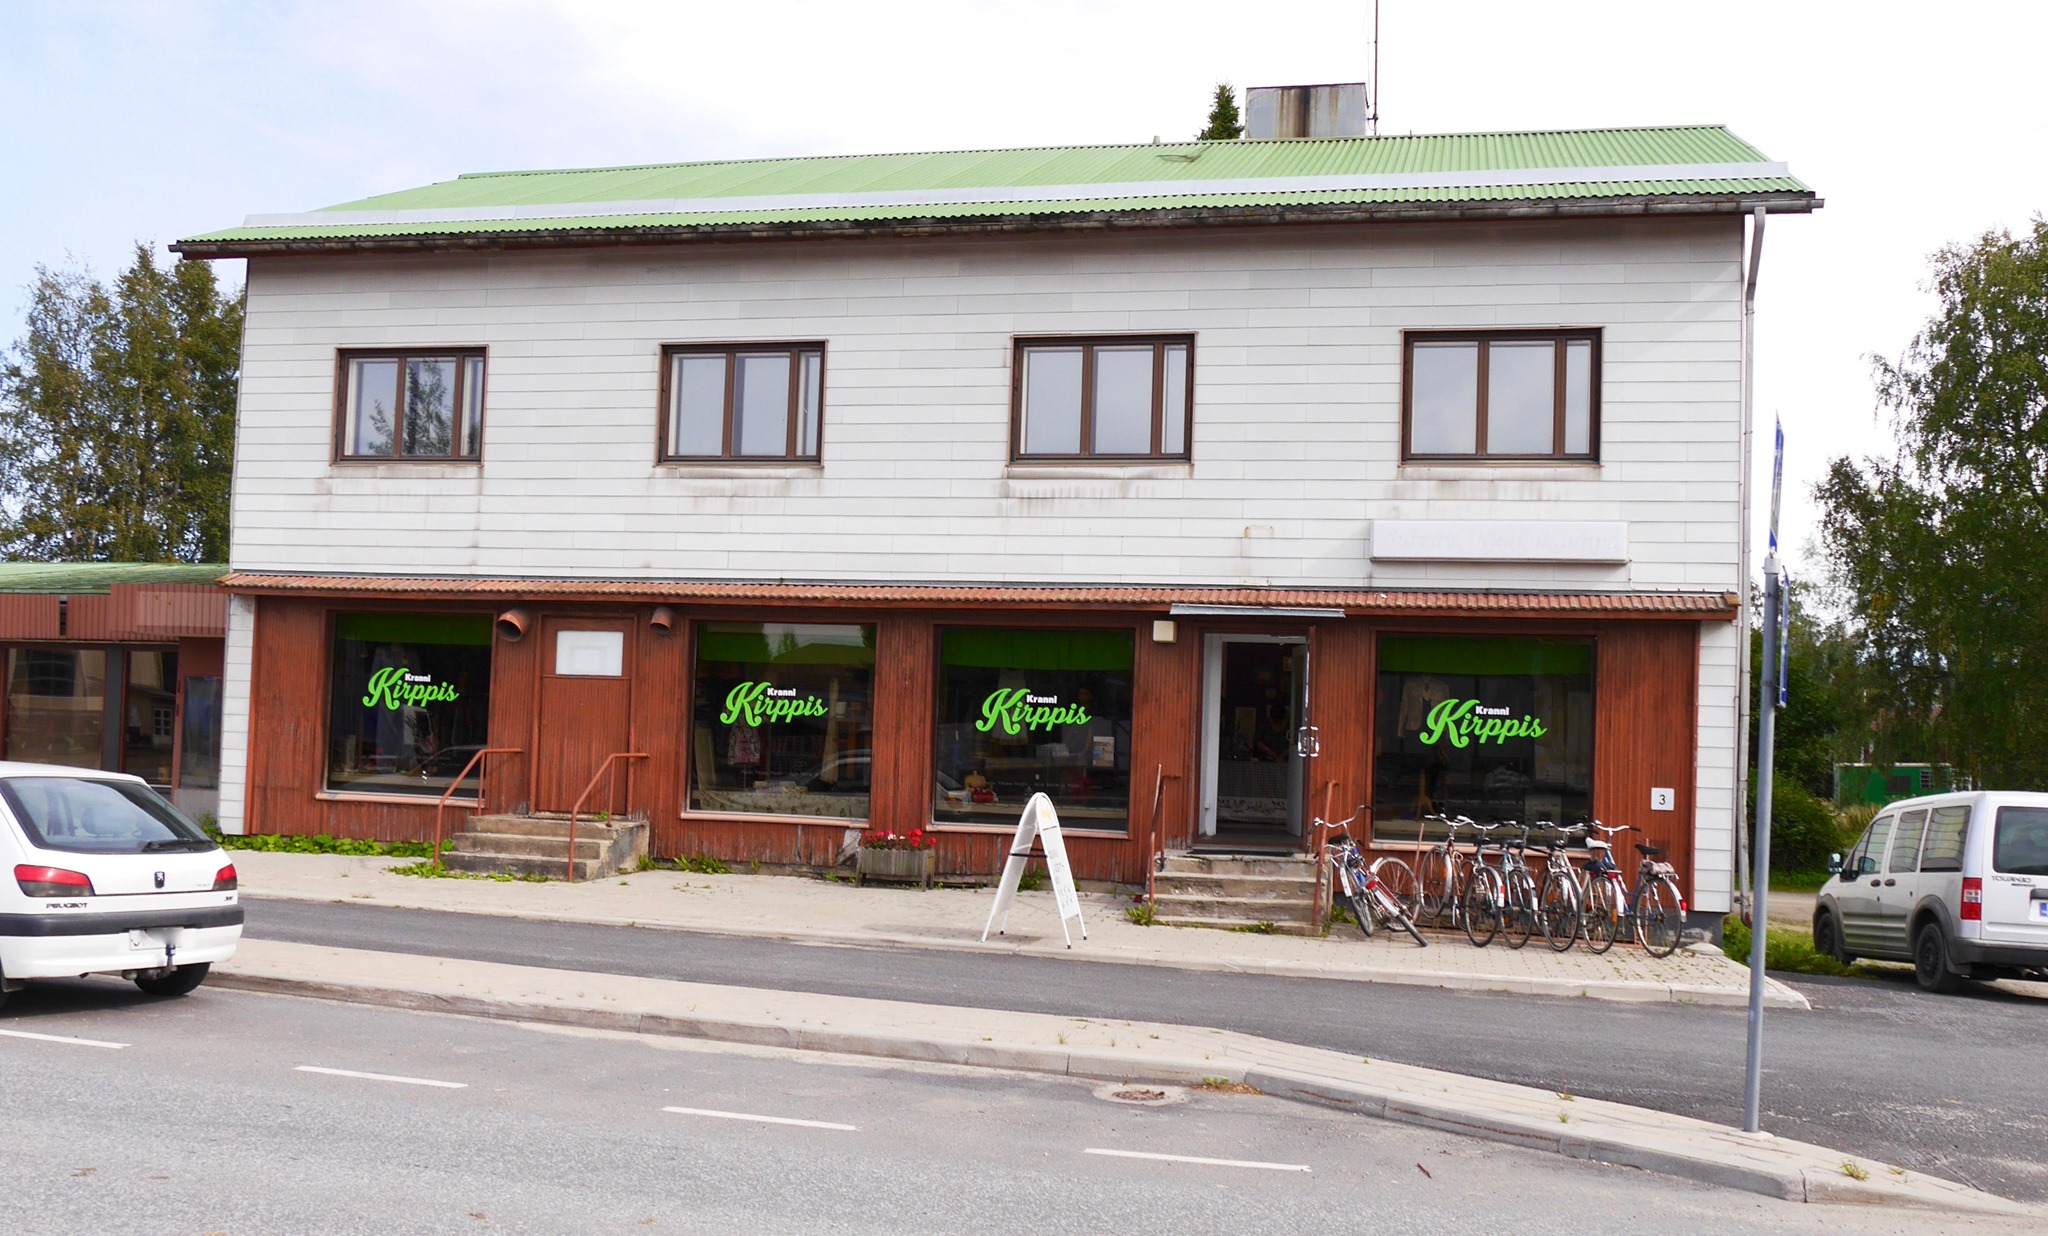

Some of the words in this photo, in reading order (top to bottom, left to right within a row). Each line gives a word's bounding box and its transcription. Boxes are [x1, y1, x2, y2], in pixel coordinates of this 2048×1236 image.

[362, 667, 459, 710] Kirppis
[720, 681, 828, 727] Kirppis
[1475, 705, 1510, 716] Kranni
[975, 687, 1092, 735] Kirppis
[1419, 698, 1547, 748] Kirppis
[1659, 794, 1666, 805] 3
